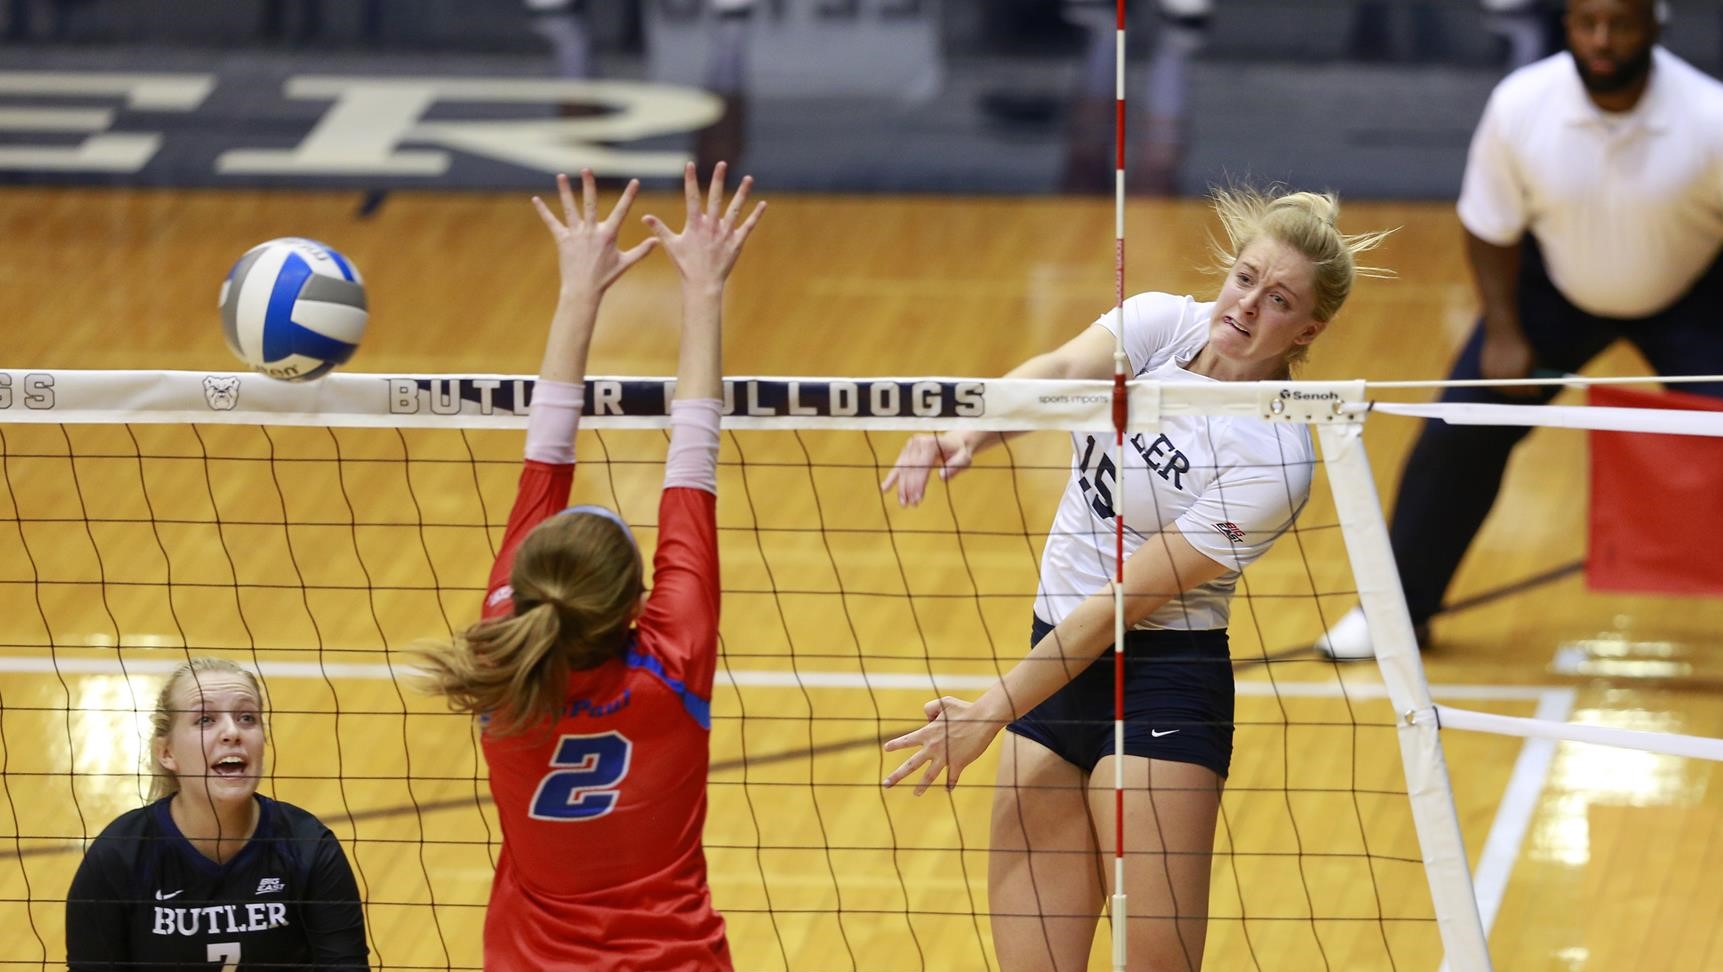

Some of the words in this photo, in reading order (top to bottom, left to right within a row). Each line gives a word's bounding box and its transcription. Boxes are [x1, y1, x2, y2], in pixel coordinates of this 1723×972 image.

[389, 379, 624, 416] BUTLR
[1039, 395, 1068, 404] sports
[1293, 391, 1339, 400] Senoh
[528, 730, 632, 822] 2
[152, 903, 289, 936] BUTLER
[207, 942, 241, 972] 7
